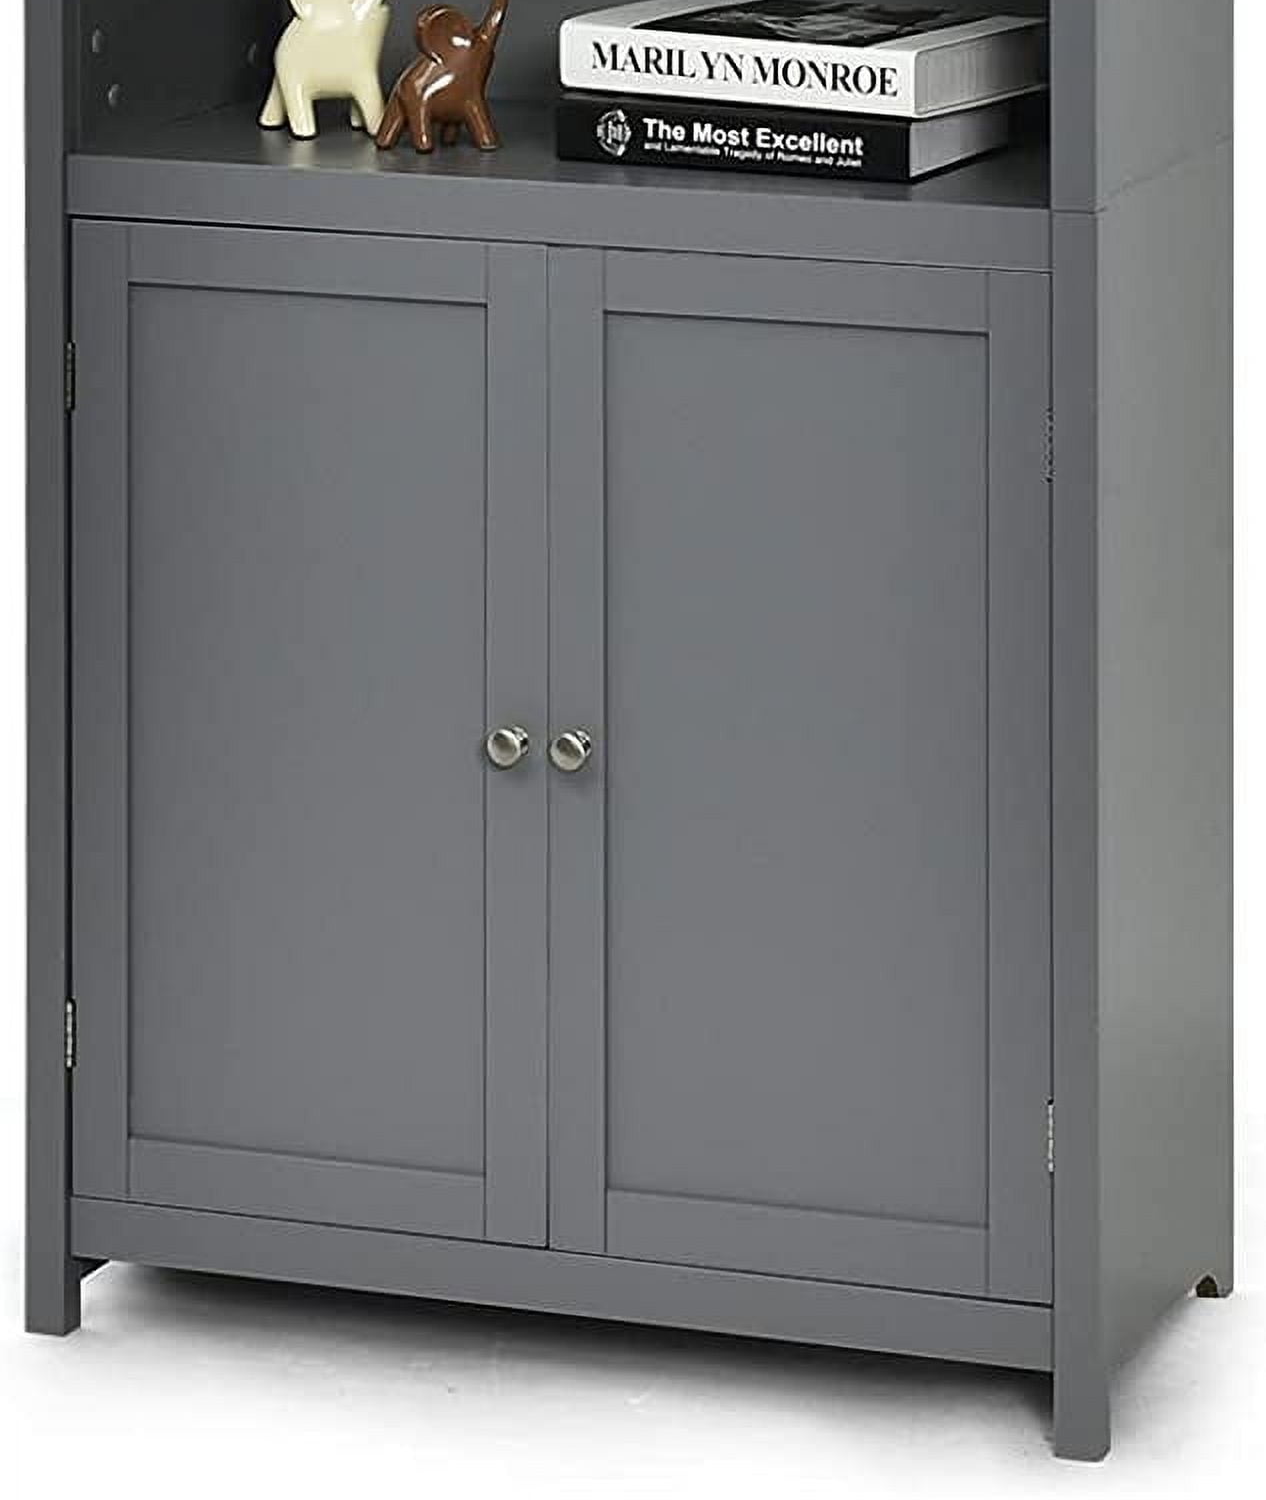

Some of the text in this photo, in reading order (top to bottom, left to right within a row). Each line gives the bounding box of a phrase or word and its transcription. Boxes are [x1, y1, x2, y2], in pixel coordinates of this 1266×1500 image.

[751, 55, 898, 98] MONROE
[642, 118, 685, 142] The
[693, 122, 750, 147] Most
[755, 127, 864, 156] Excellent
